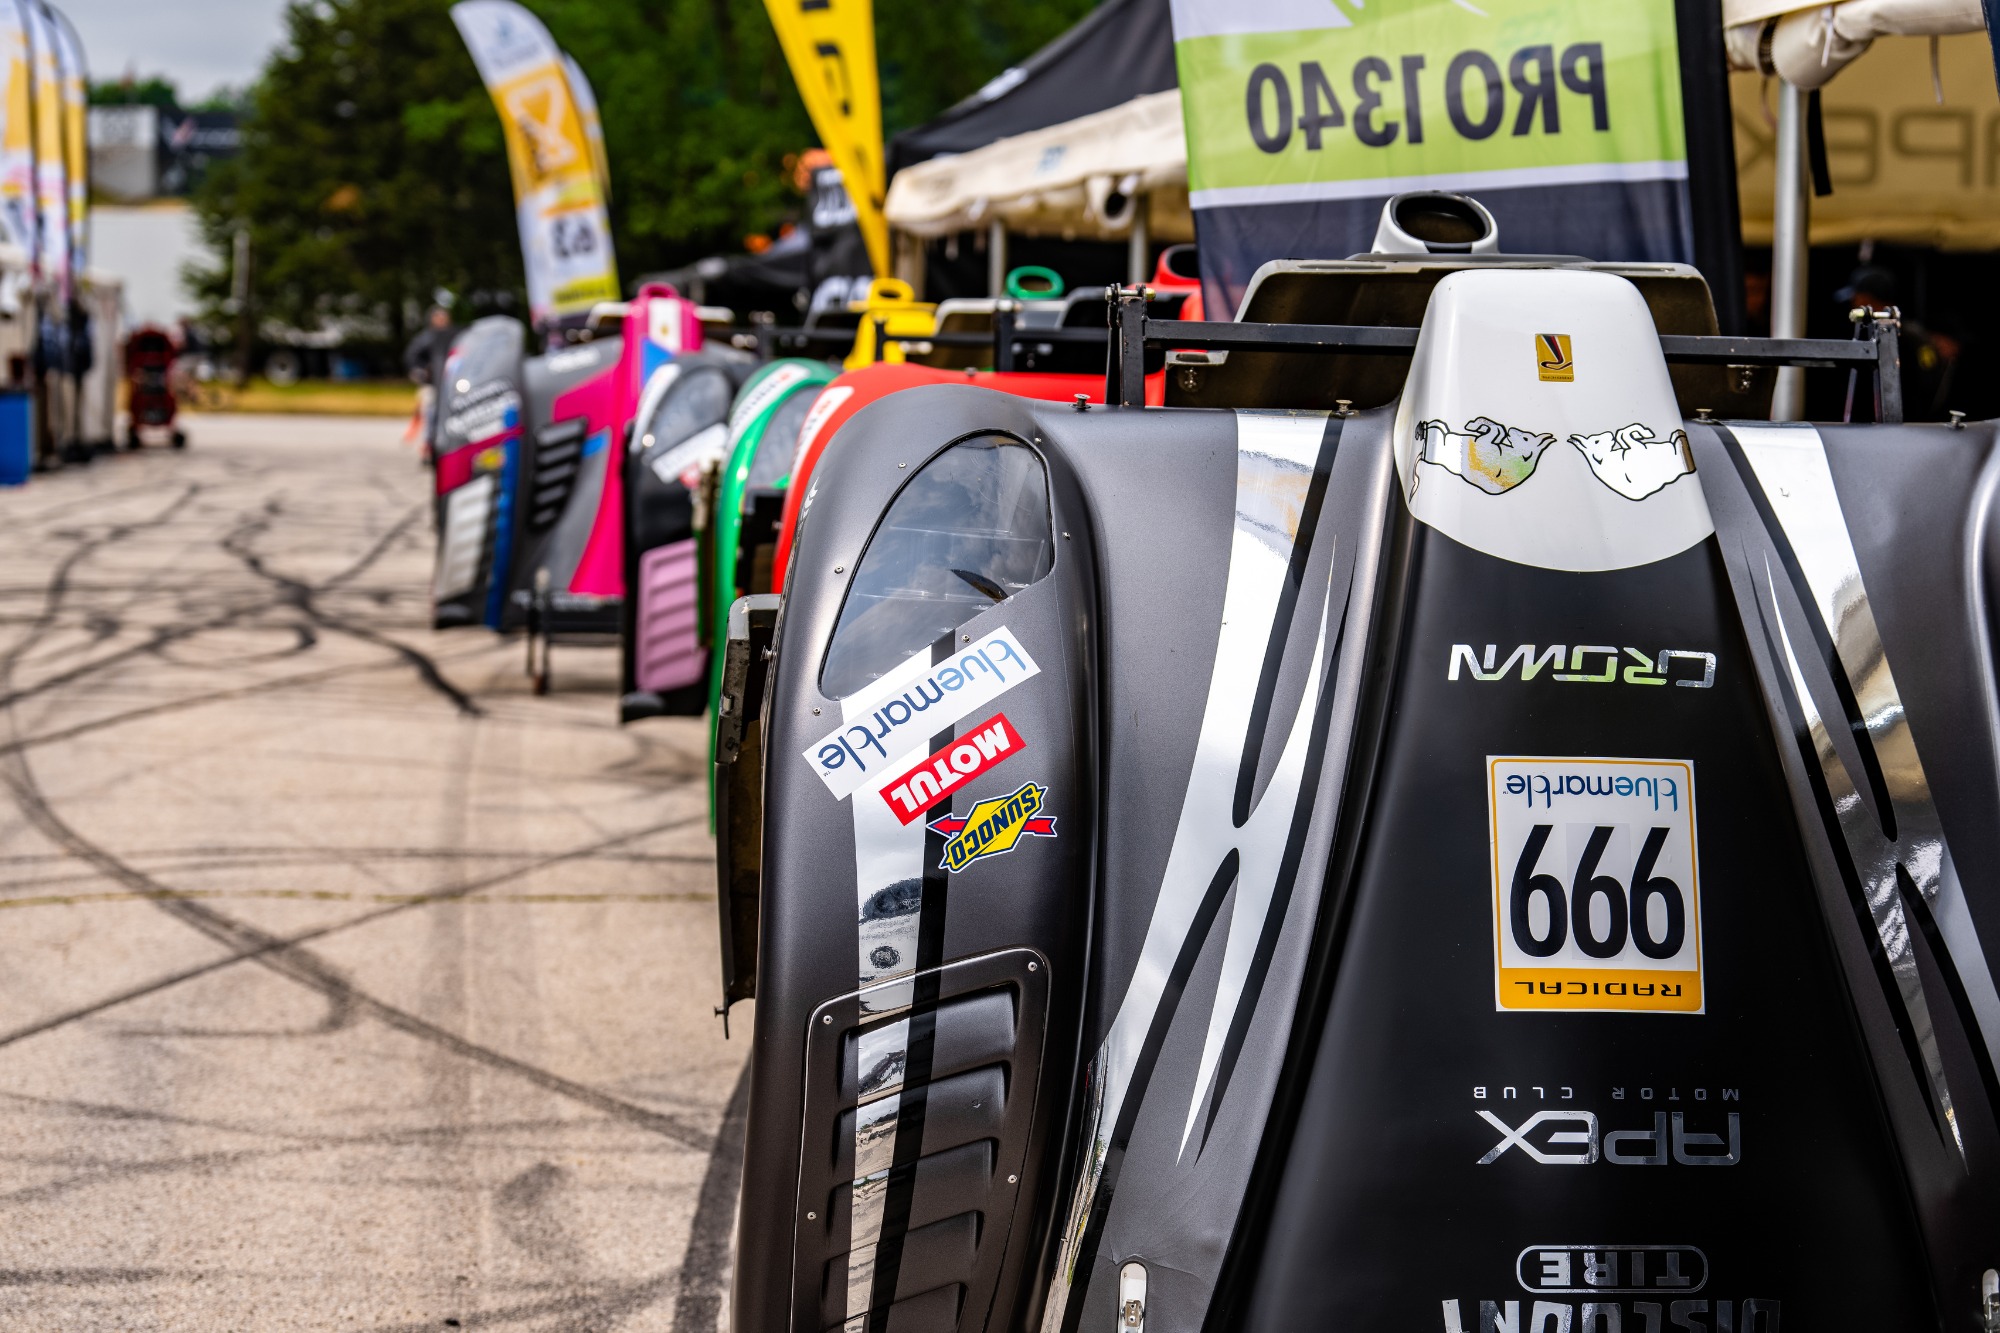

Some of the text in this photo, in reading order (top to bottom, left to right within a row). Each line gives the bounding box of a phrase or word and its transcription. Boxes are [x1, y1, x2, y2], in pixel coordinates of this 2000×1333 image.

[1447, 644, 1717, 688] CROWN
[817, 639, 1027, 773] bluemarble
[891, 721, 1011, 814] MOTUL
[1506, 774, 1679, 812] bluemarble
[949, 789, 1037, 867] SUNOCO
[1514, 981, 1682, 997] RADICAL
[1473, 1086, 1740, 1101] MOTOR CLUB
[1475, 1110, 1741, 1166] APEX
[1539, 1251, 1690, 1286] TIRE
